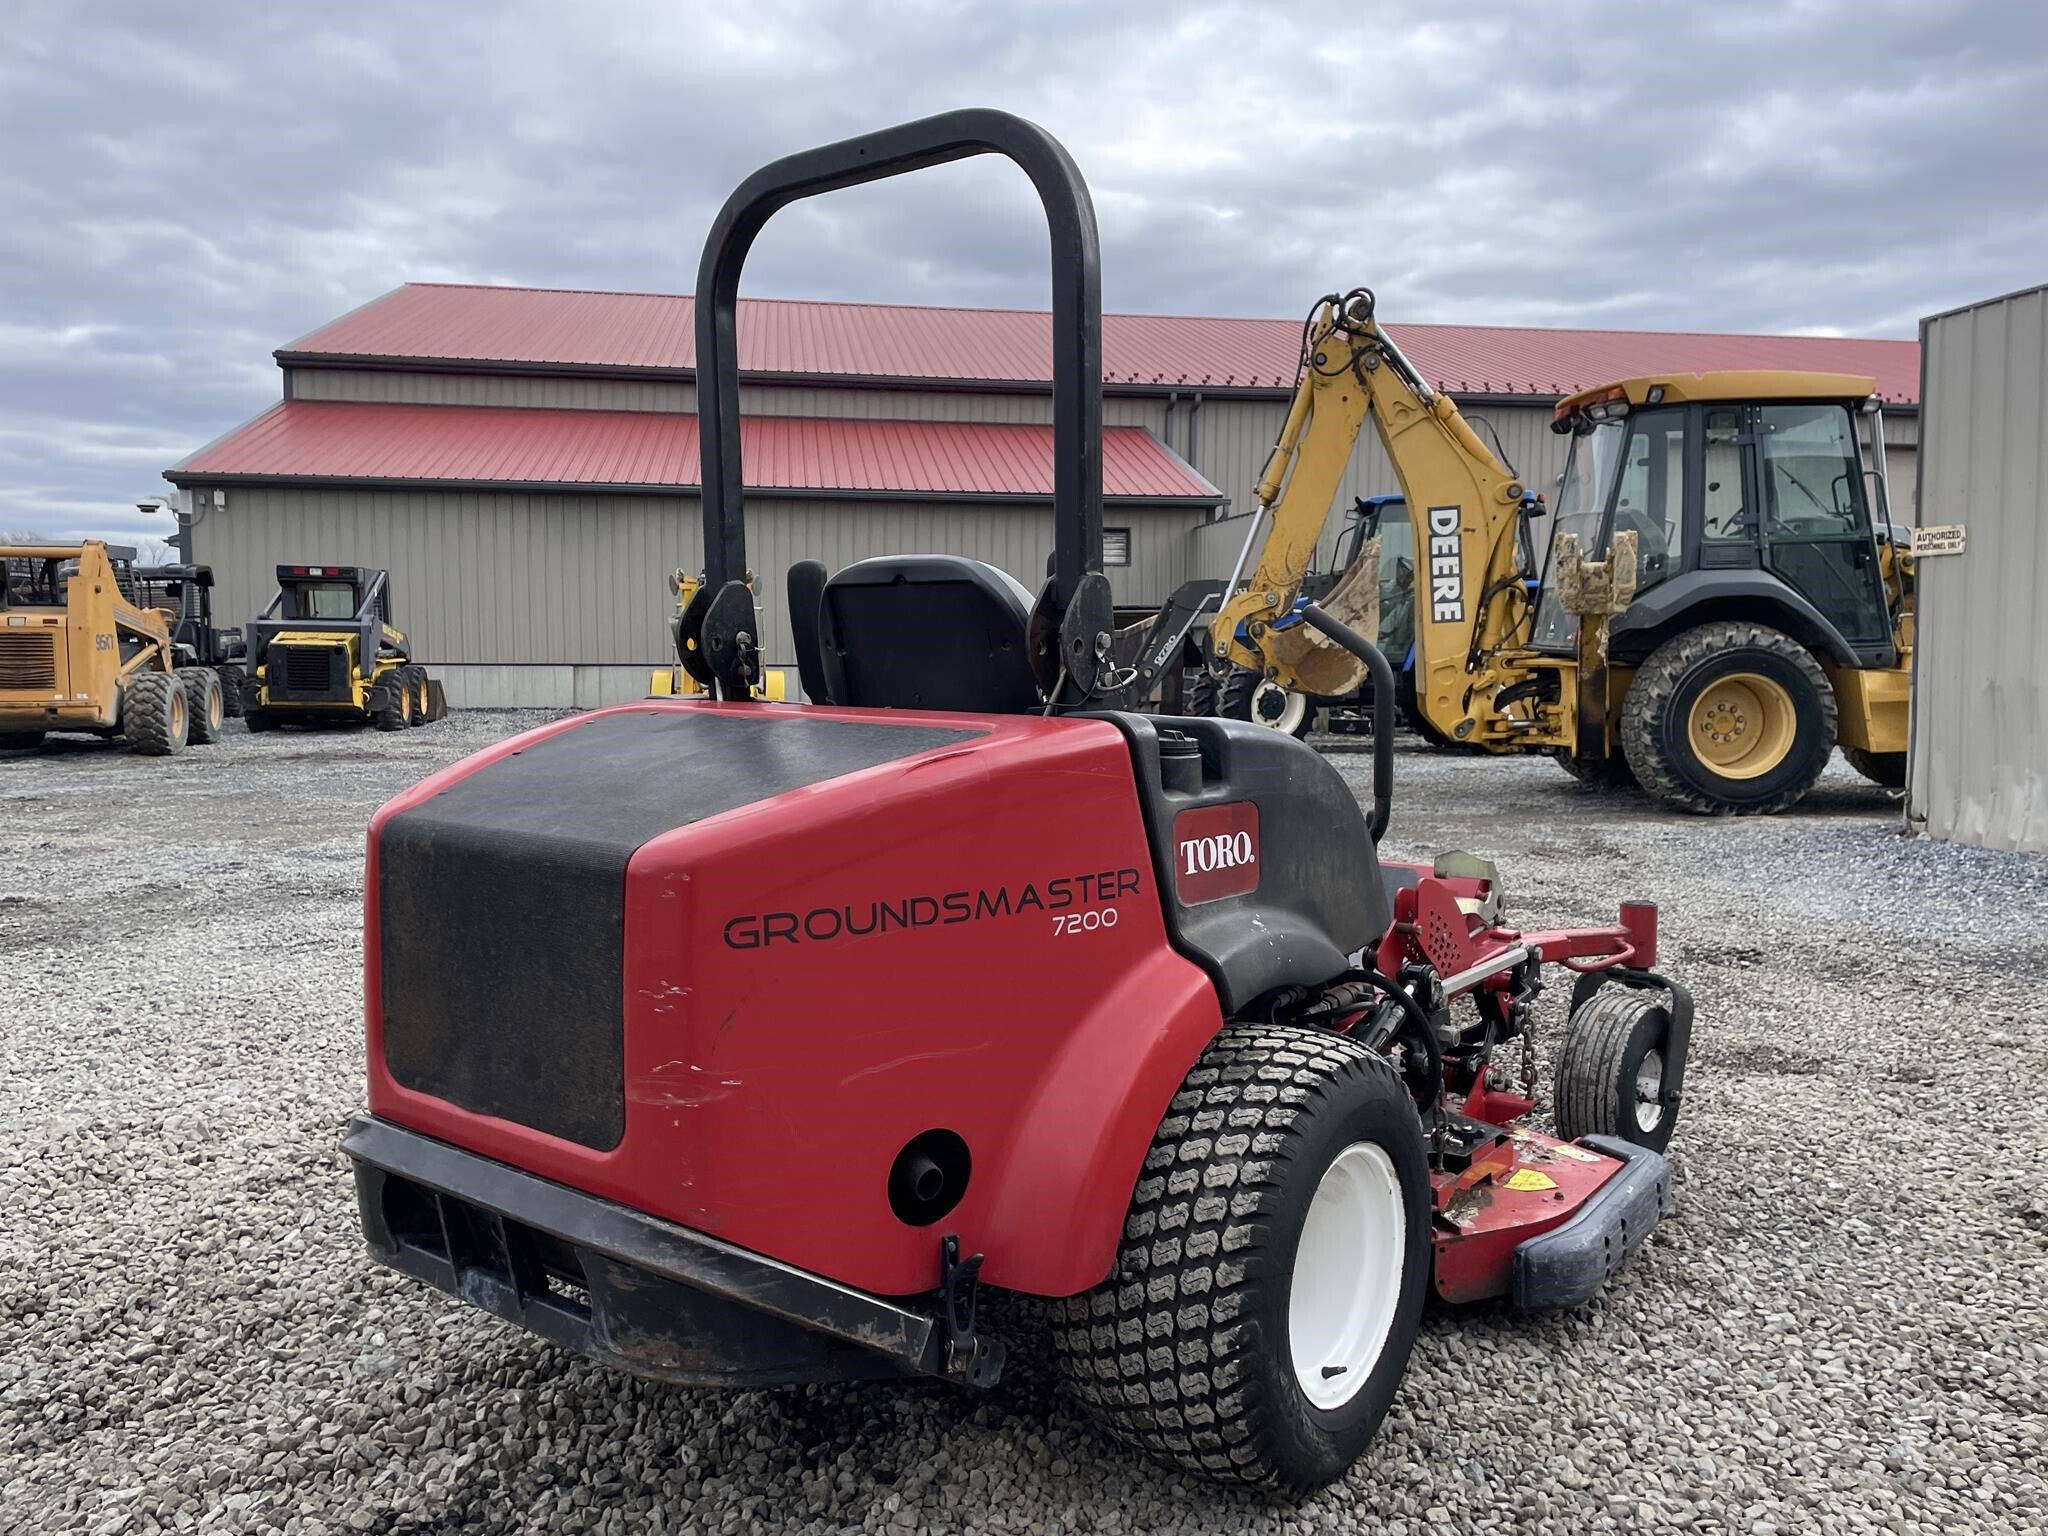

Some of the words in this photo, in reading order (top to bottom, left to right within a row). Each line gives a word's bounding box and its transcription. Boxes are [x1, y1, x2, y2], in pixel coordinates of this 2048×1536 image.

[1916, 542, 1946, 551] PERSONNEL
[1947, 541, 1960, 550] ONLY
[1917, 530, 1961, 542] AUTHORIZED
[1429, 508, 1462, 622] DEERE
[1180, 831, 1253, 875] TORO
[722, 867, 1141, 949] GROUNDSMASTER
[1051, 910, 1119, 937] 7200
